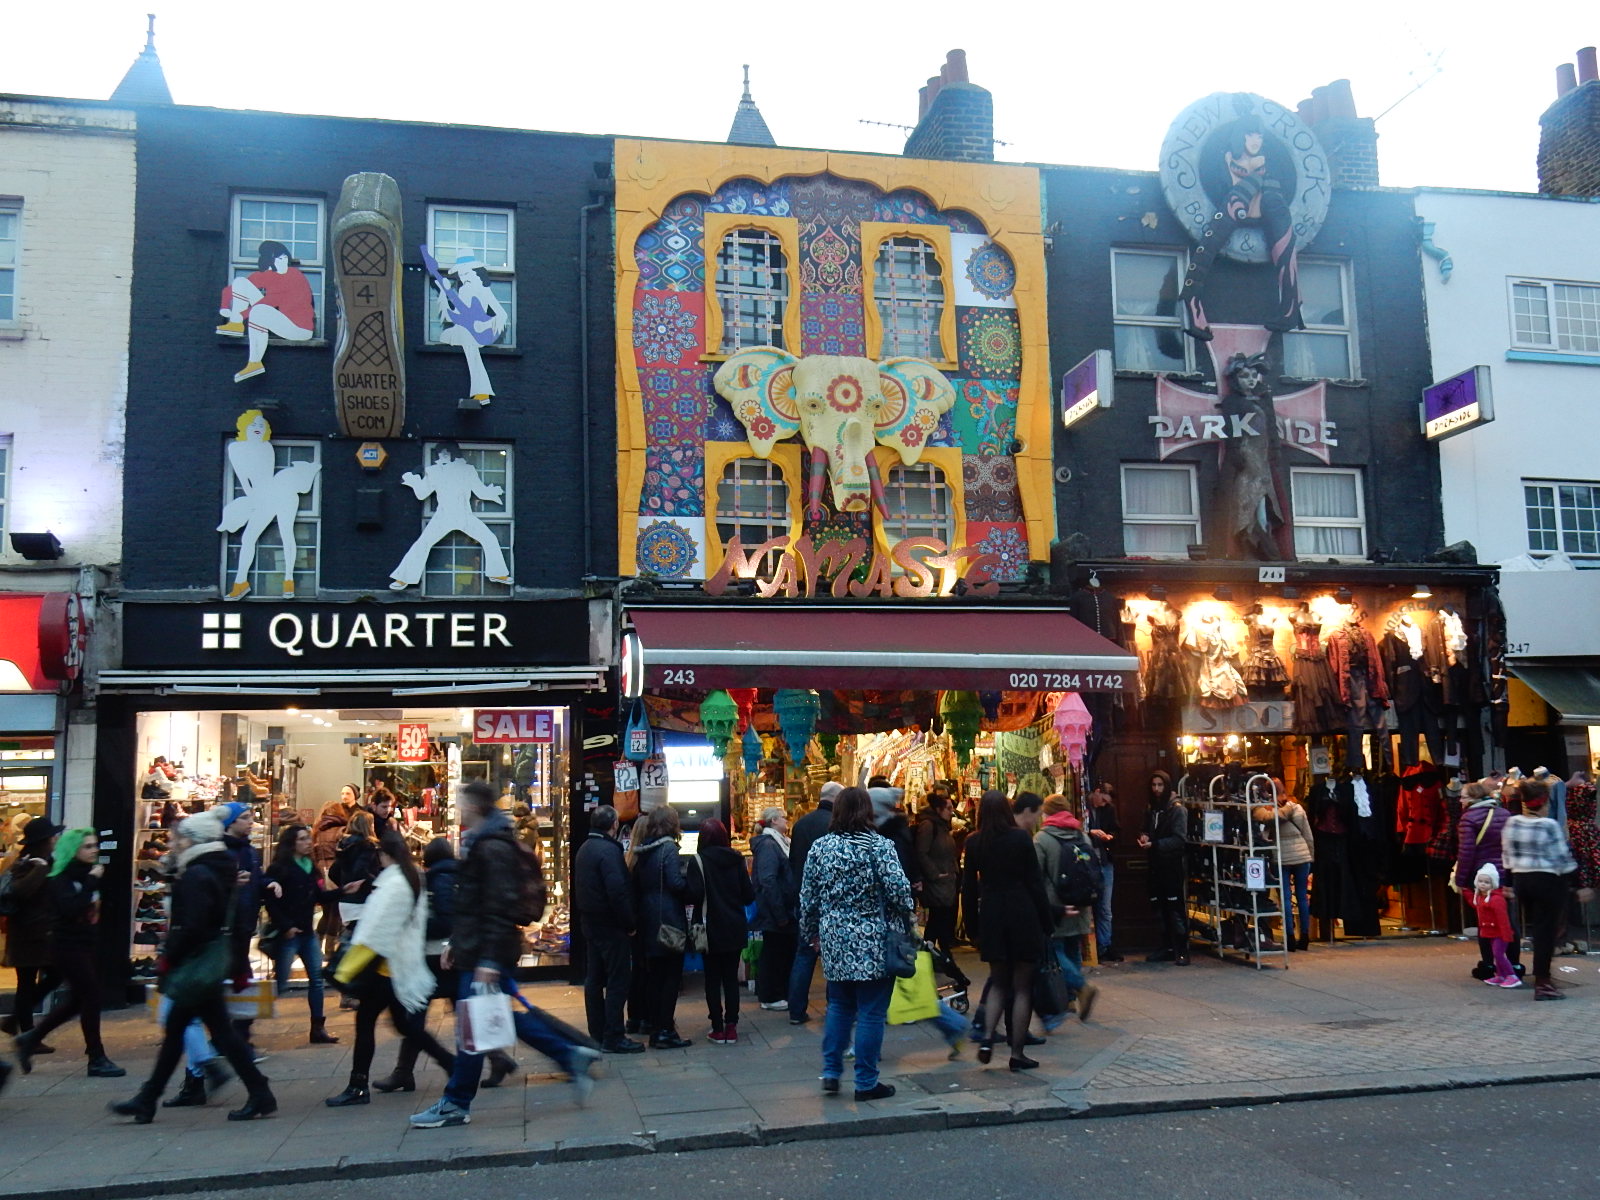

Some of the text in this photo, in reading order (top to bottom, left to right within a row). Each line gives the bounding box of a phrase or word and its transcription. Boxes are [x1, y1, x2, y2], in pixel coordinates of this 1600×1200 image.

[1168, 97, 1326, 204] NEW ROCK
[356, 284, 375, 305] 4
[337, 373, 397, 389] QUARTER
[346, 395, 390, 410] SHOES
[1148, 412, 1260, 440] DARK
[268, 612, 513, 656] QUARTER
[1508, 643, 1530, 654] 247
[663, 669, 695, 685] 243
[1009, 673, 1123, 689] 020 7284 1742
[477, 714, 550, 739] SALE
[400, 727, 428, 750] 50%
[401, 748, 425, 758] OFF
